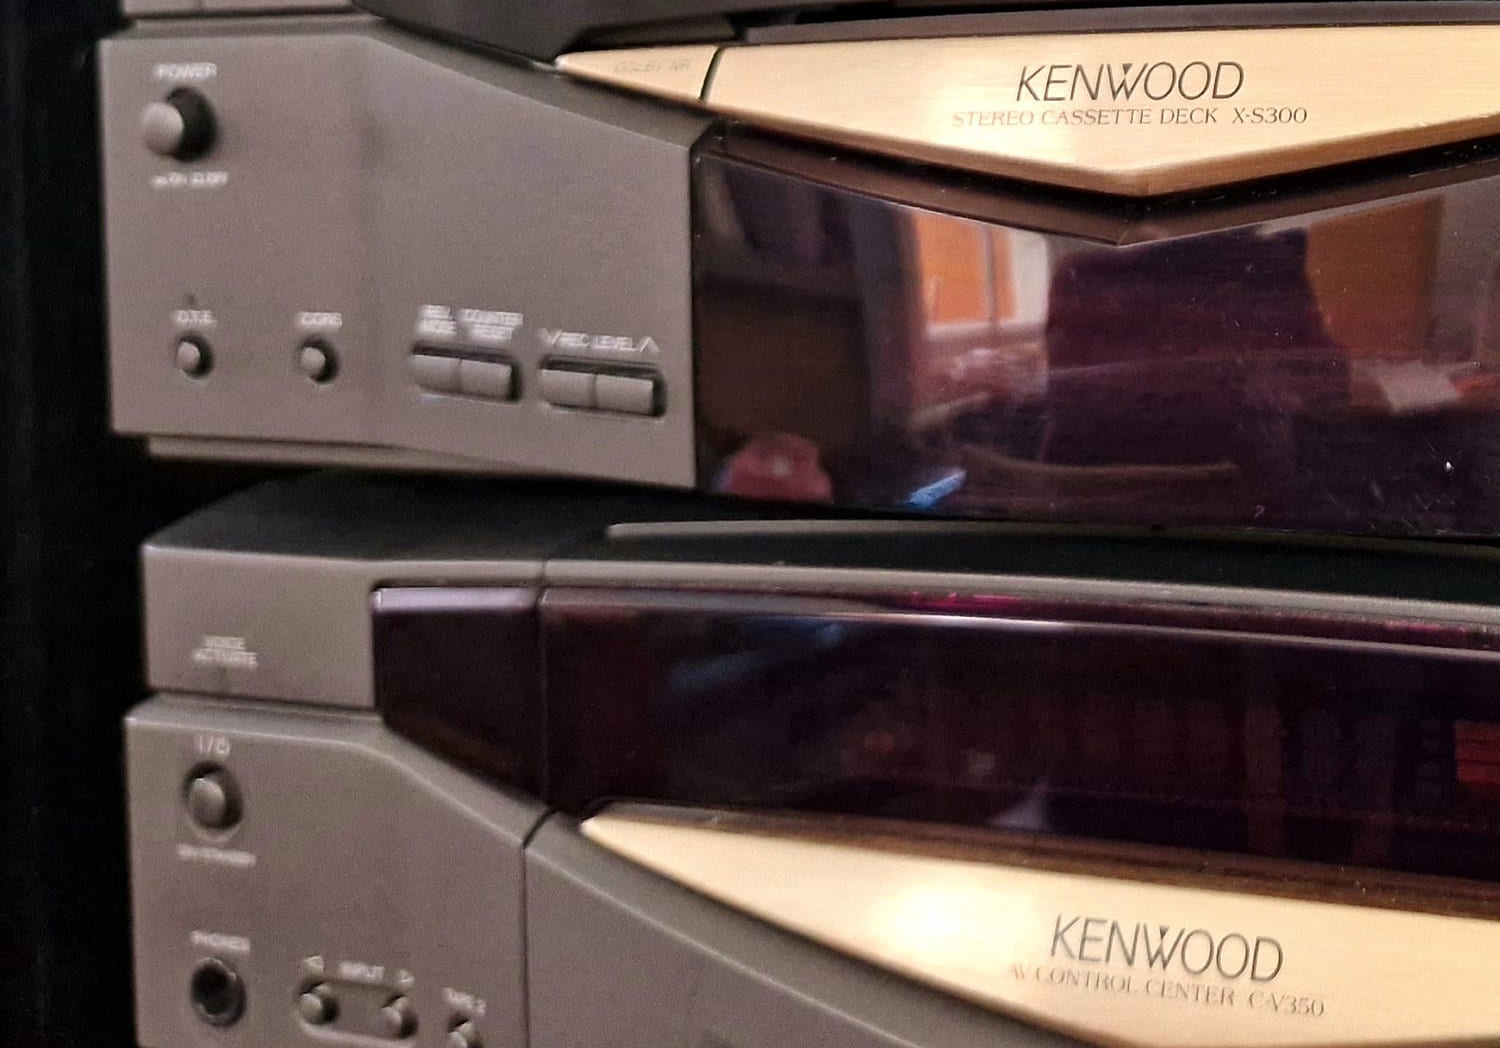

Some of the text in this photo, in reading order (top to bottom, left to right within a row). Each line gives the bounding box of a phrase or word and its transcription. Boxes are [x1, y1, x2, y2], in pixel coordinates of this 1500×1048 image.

[1015, 60, 1245, 102] KENWOOD
[952, 105, 1308, 127] STEREO CASSETTE DECK X-S300
[1050, 914, 1285, 983] KENWOOD
[1035, 966, 1138, 995] CONTROL
[1145, 977, 1235, 1007] CENTER
